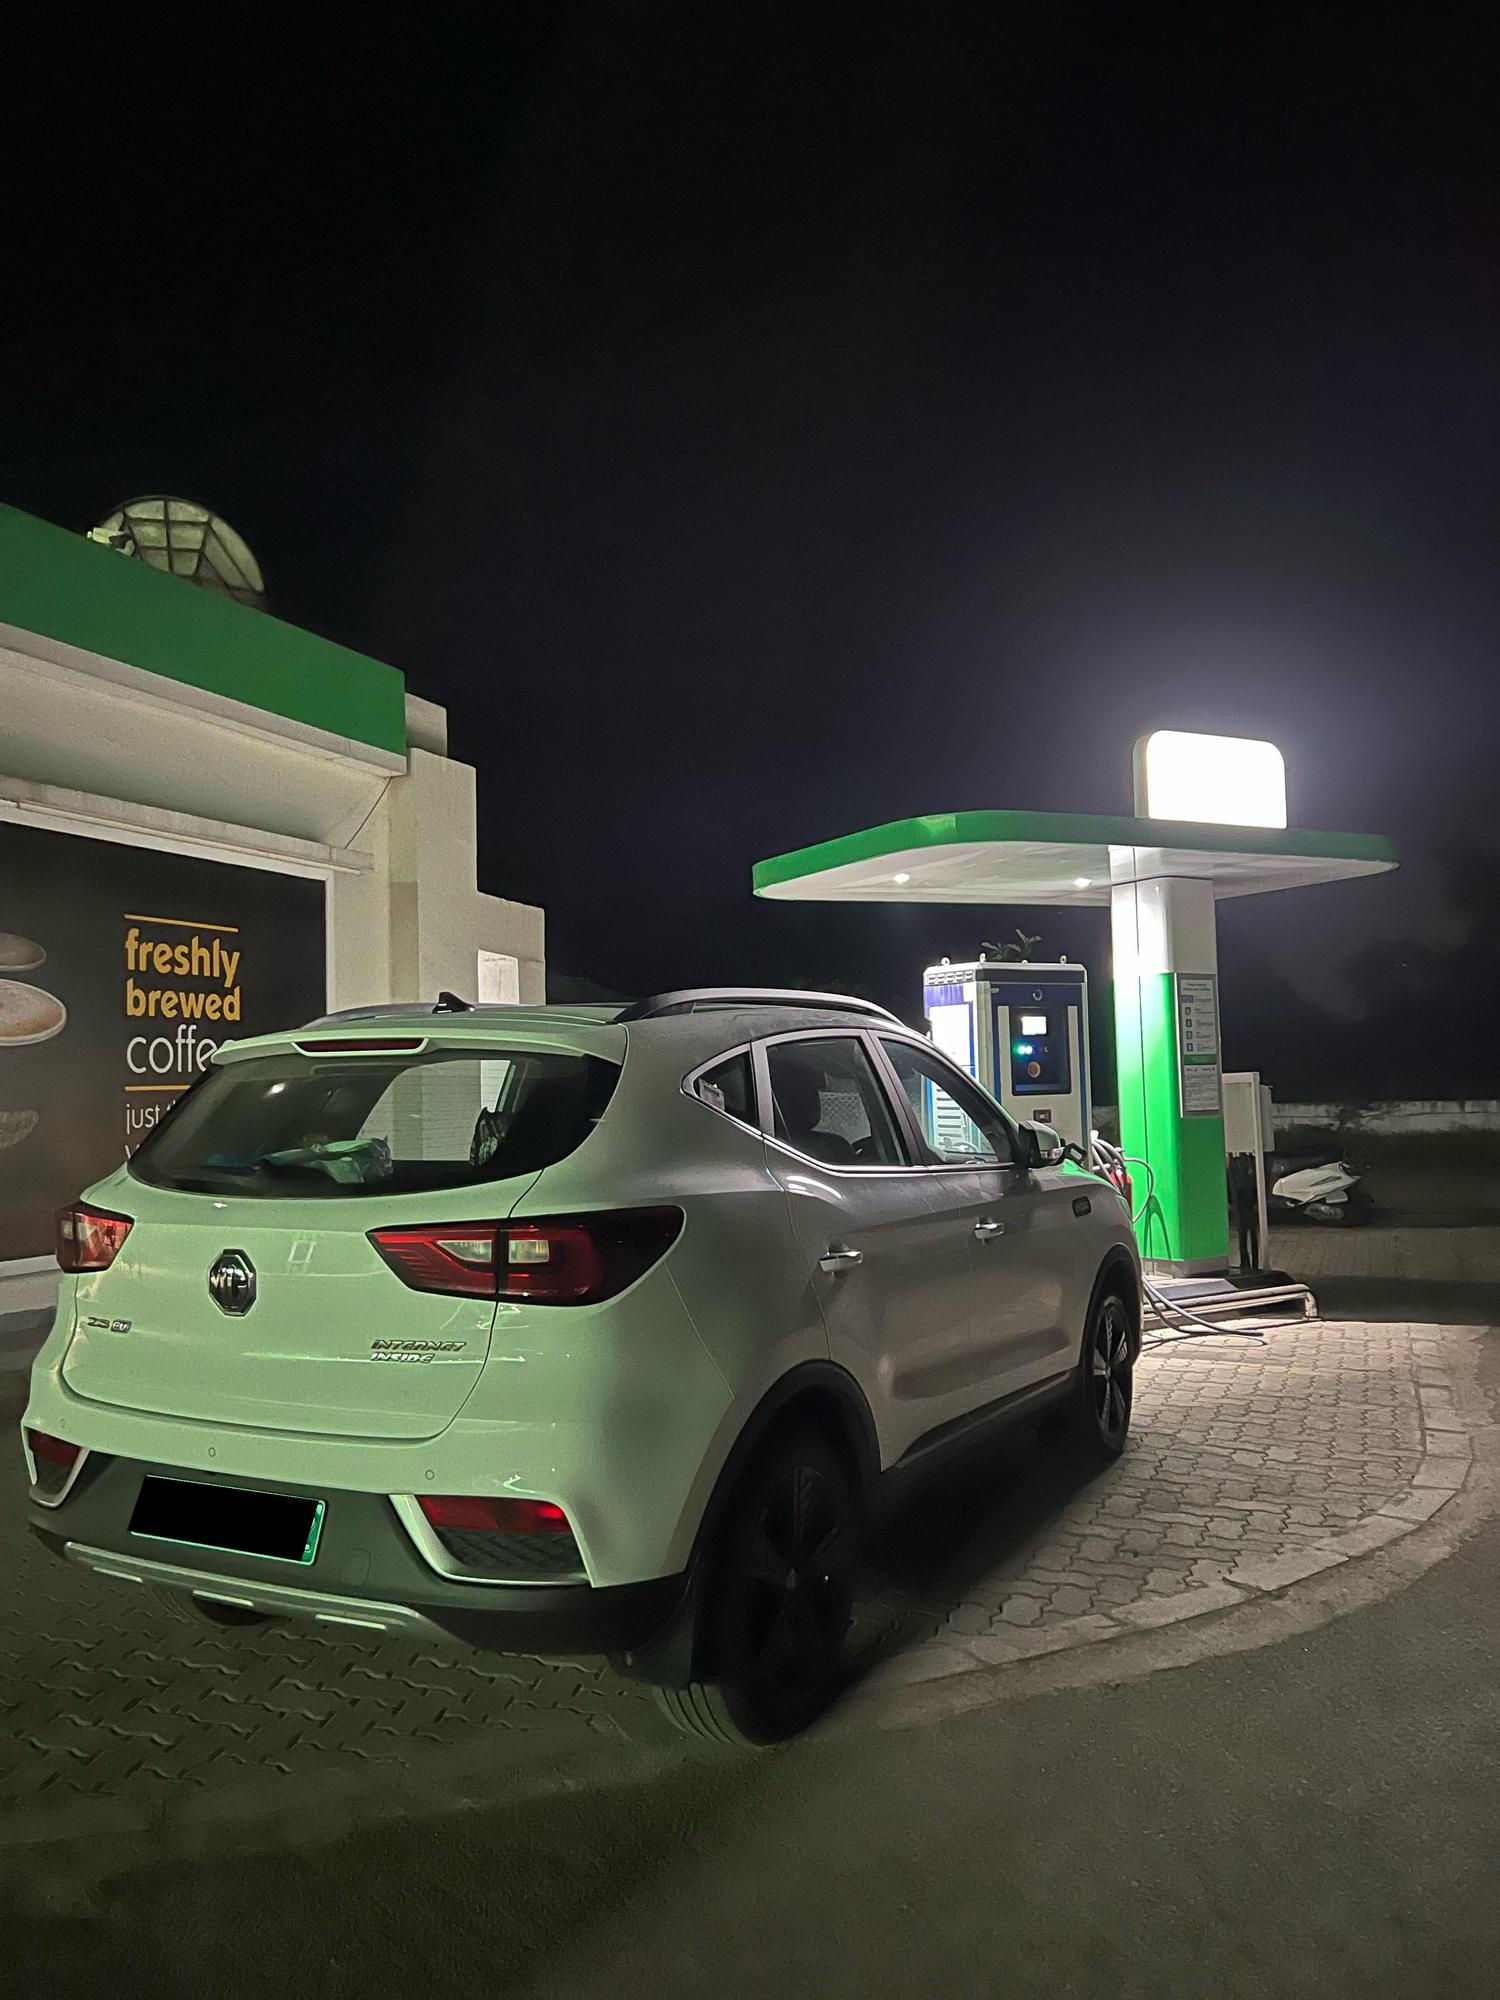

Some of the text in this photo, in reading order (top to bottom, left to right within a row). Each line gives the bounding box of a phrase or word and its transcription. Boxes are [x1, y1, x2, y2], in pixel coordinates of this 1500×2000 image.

[125, 928, 240, 988] freshly
[127, 978, 240, 1021] brewed
[127, 1024, 233, 1074] coffe
[126, 1104, 160, 1135] just
[87, 1316, 131, 1333] ZS EV
[371, 1339, 467, 1352] INTERNET
[371, 1352, 435, 1364] INSIDE
